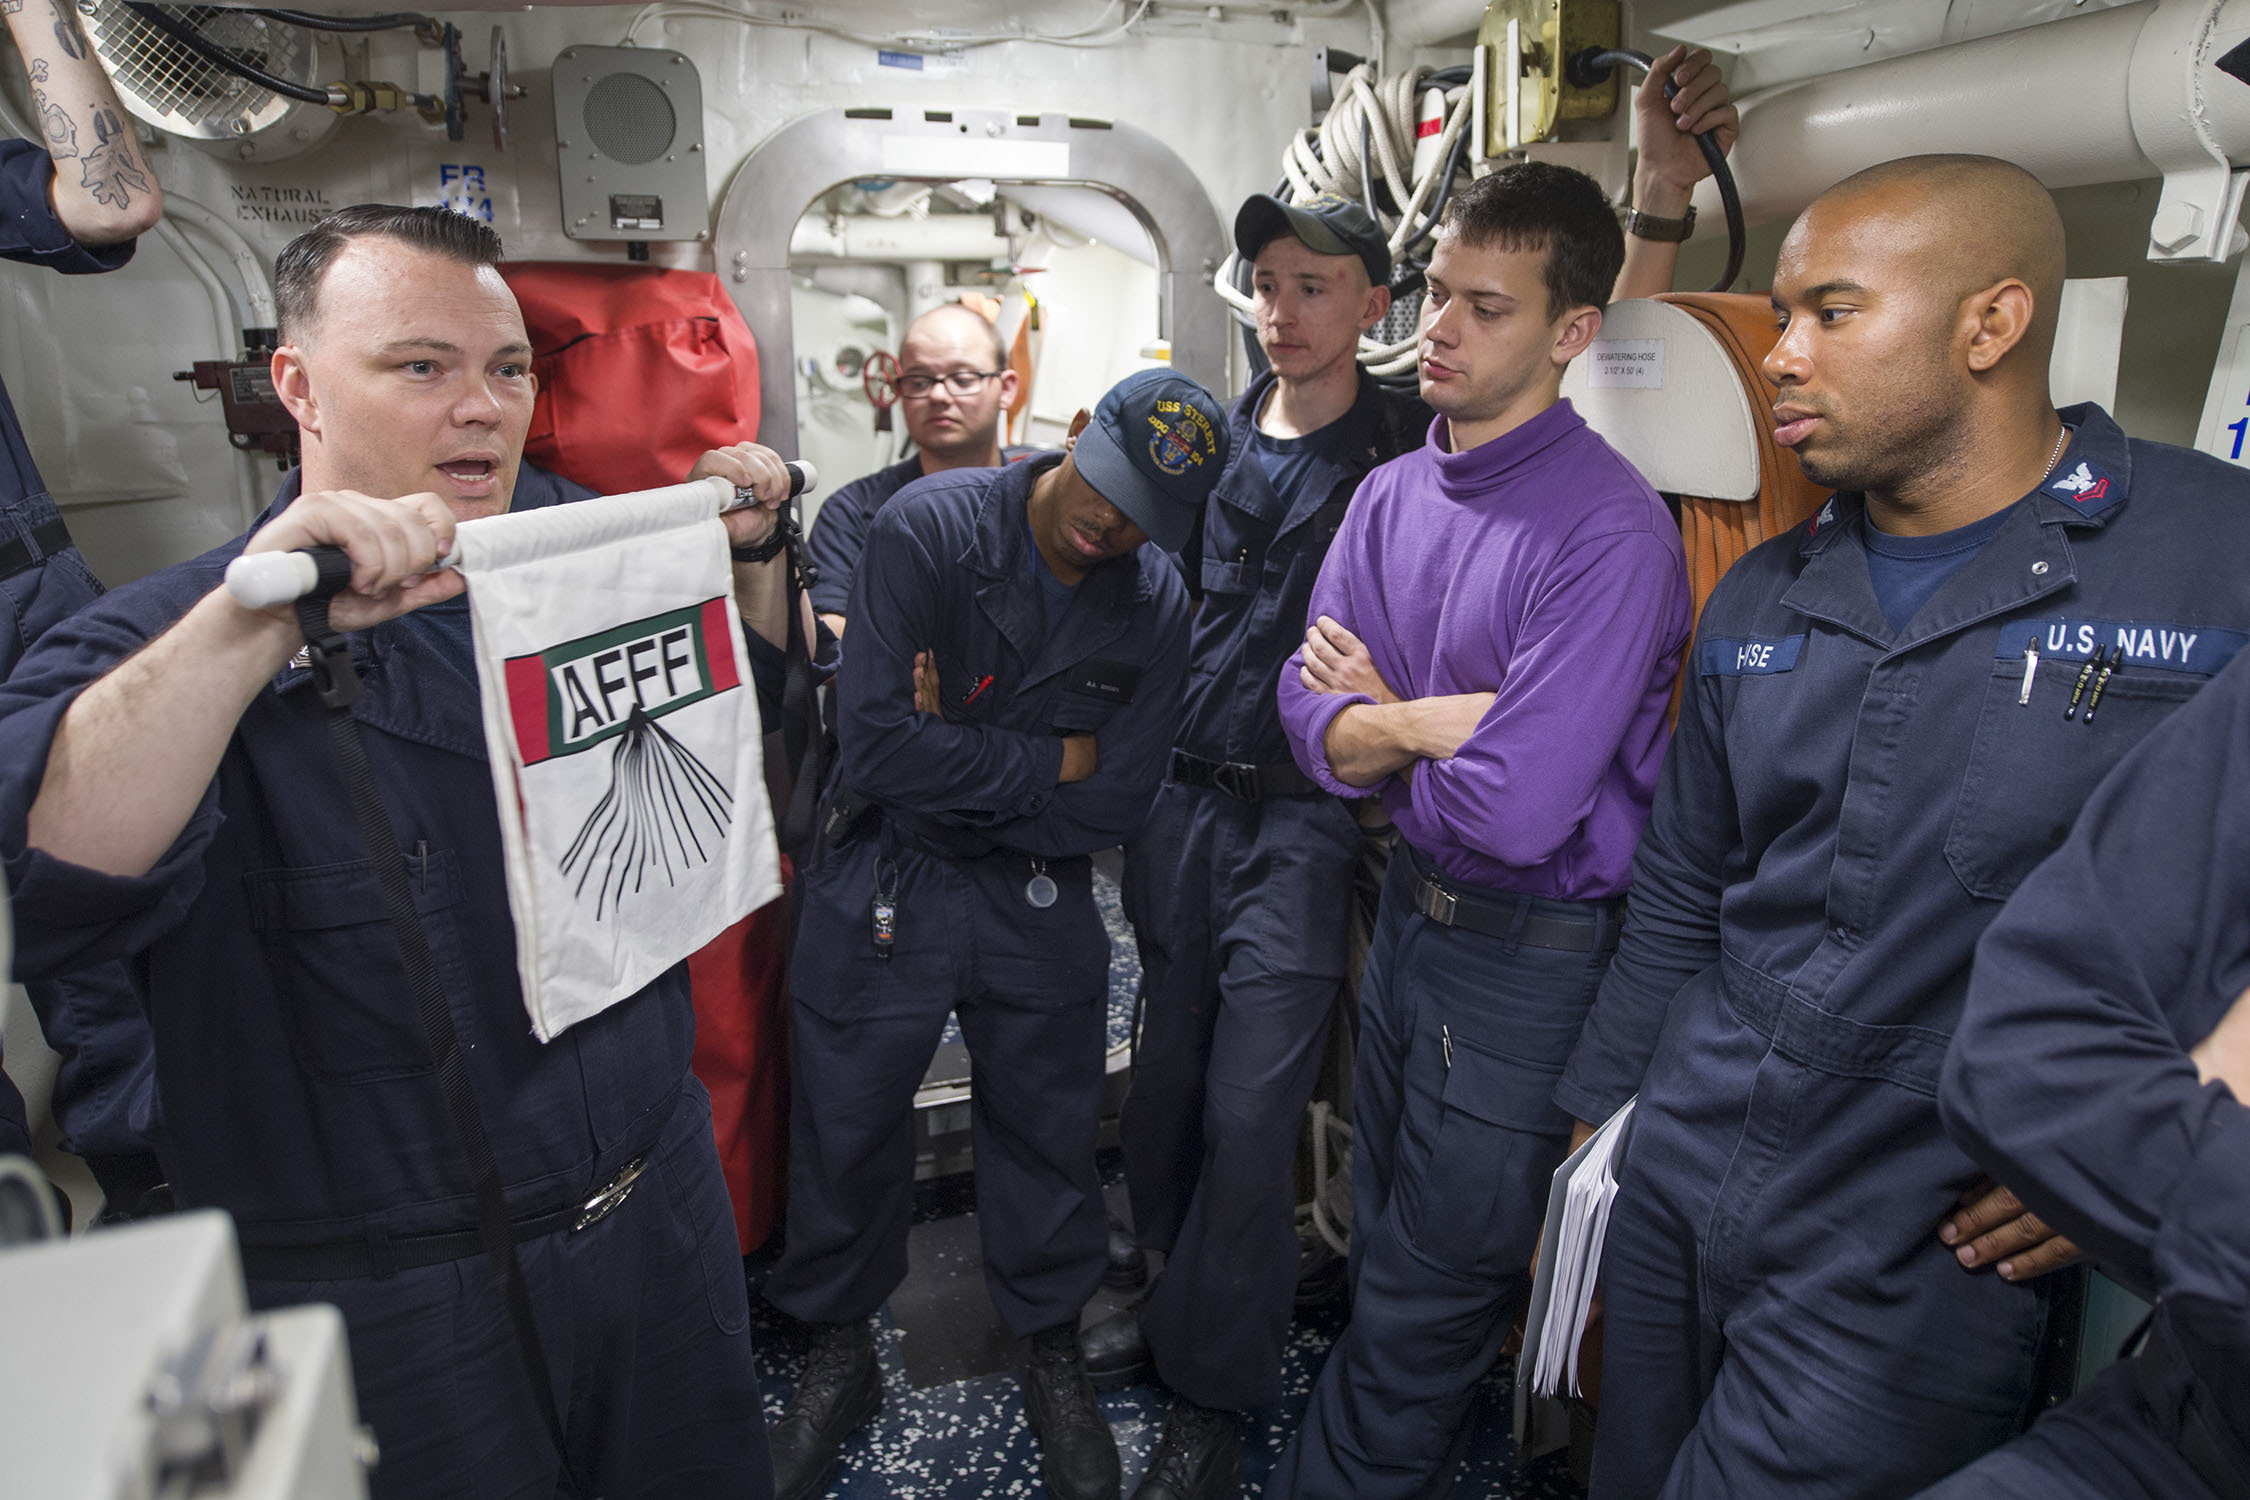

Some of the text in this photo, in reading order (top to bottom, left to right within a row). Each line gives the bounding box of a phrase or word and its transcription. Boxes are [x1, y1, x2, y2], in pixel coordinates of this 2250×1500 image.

[440, 164, 485, 191] FR
[231, 186, 330, 204] NATURAL
[1596, 352, 1656, 361] DEWATERING HOSE
[1157, 400, 1181, 413] USS
[1147, 414, 1170, 434] DDG
[2117, 628, 2198, 663] NAVY
[563, 628, 688, 739] AFFF
